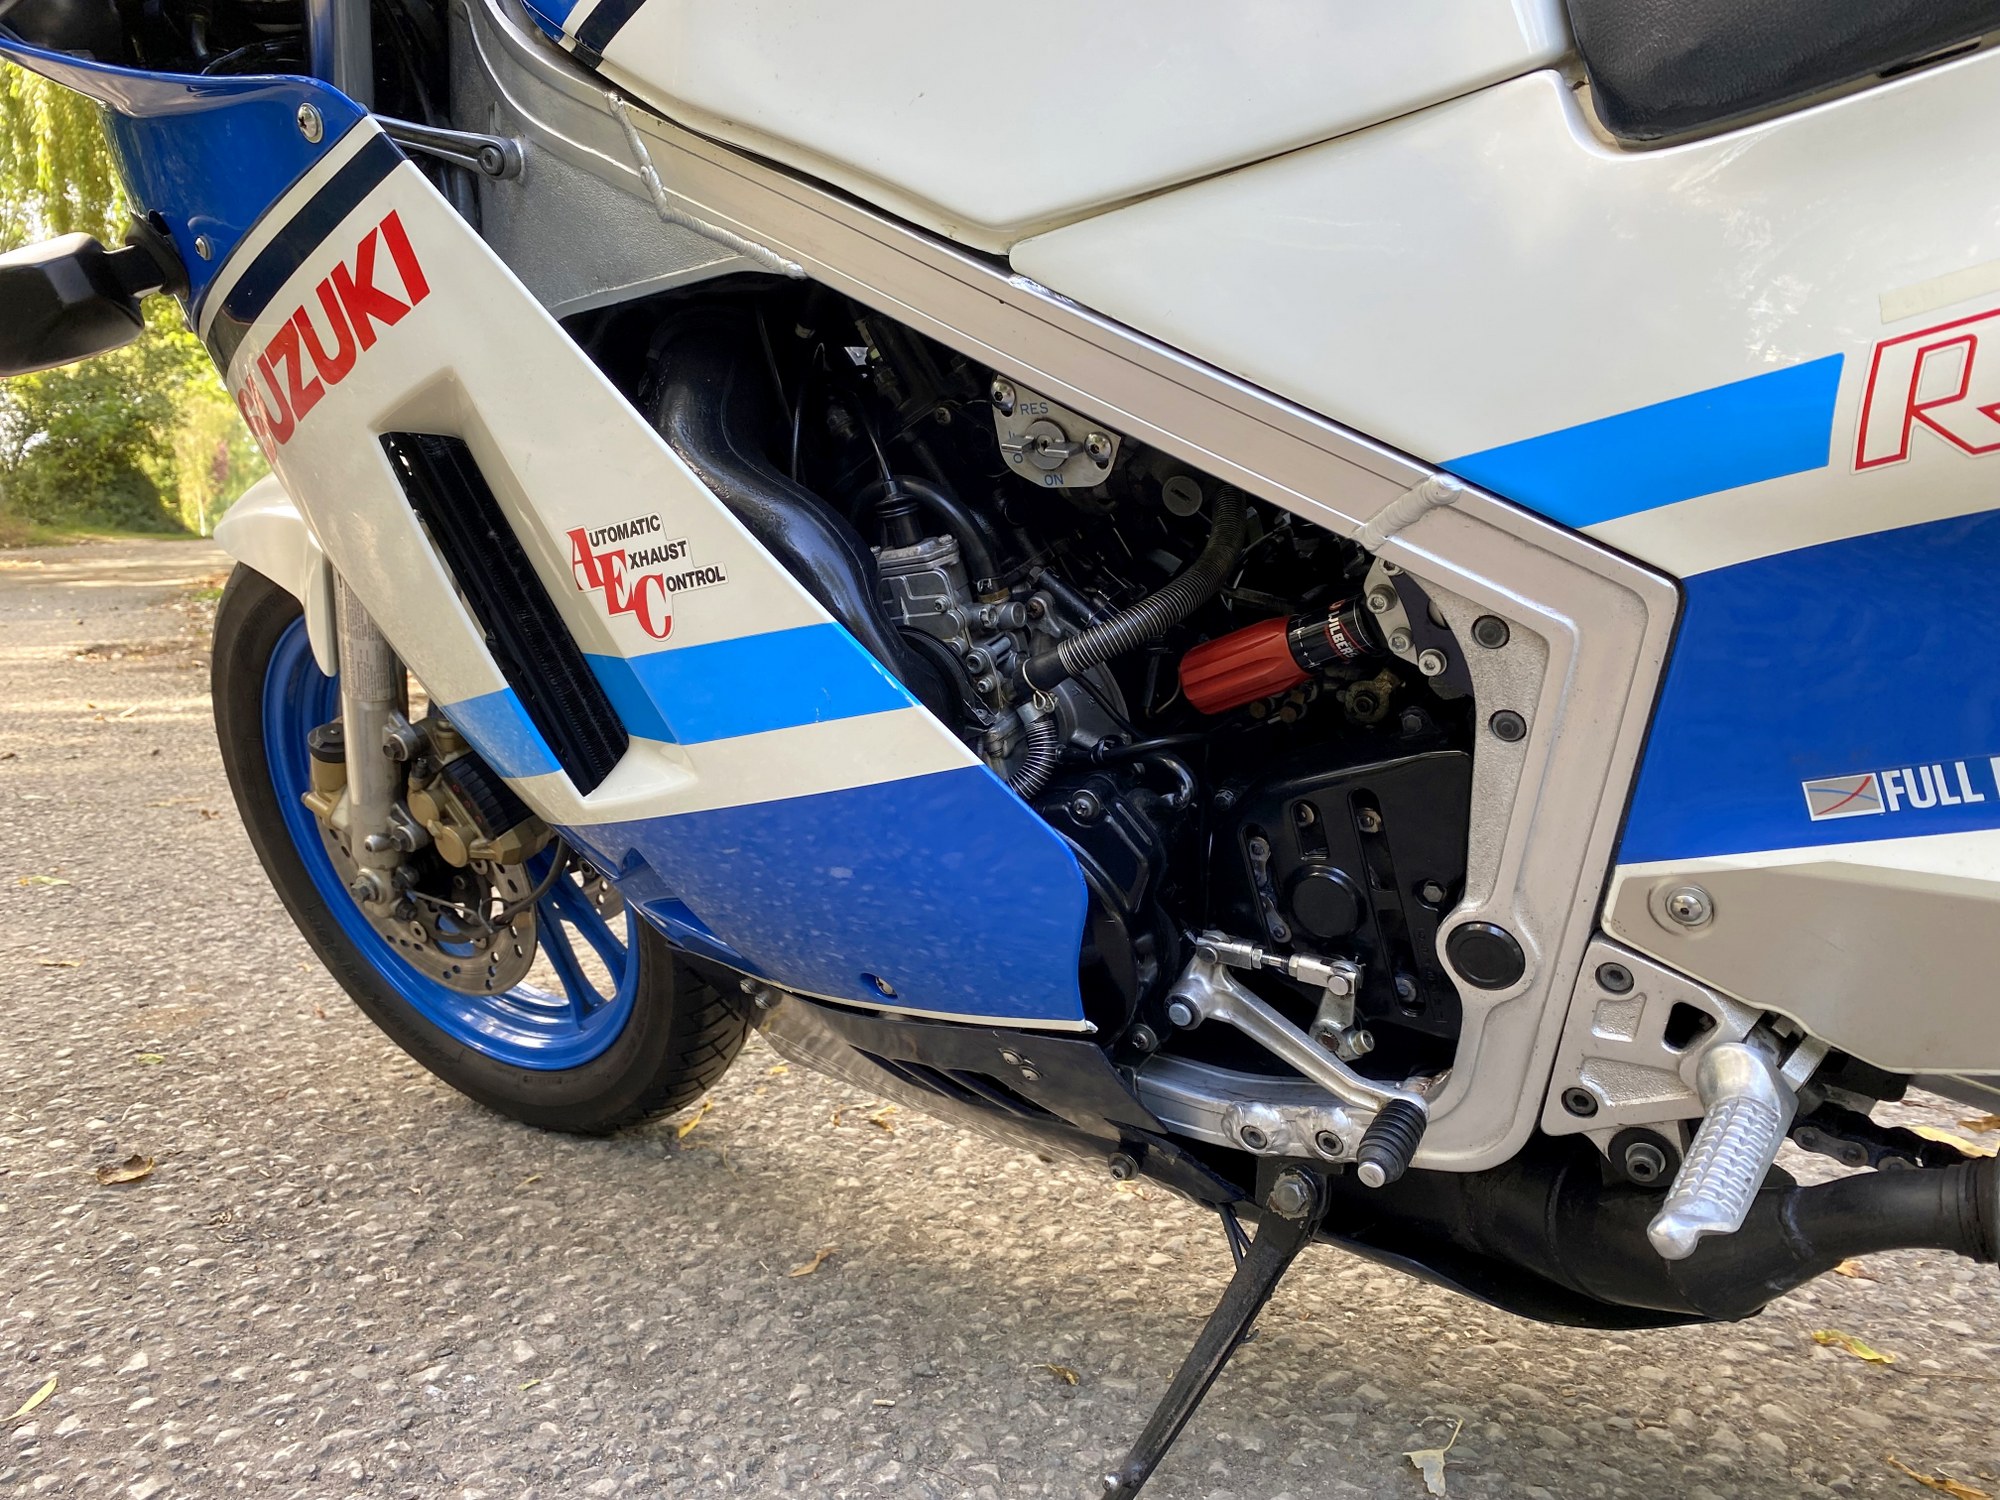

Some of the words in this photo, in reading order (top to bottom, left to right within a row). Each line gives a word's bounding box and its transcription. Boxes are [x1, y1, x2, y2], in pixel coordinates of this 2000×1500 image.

[238, 209, 431, 464] SUZUKI
[1020, 402, 1048, 415] RES
[1044, 474, 1064, 486] ON
[566, 514, 661, 591] AUTOMATIC
[593, 540, 687, 615] EXHAUST
[633, 566, 725, 638] CONTROL
[1881, 761, 1985, 812] FULL
